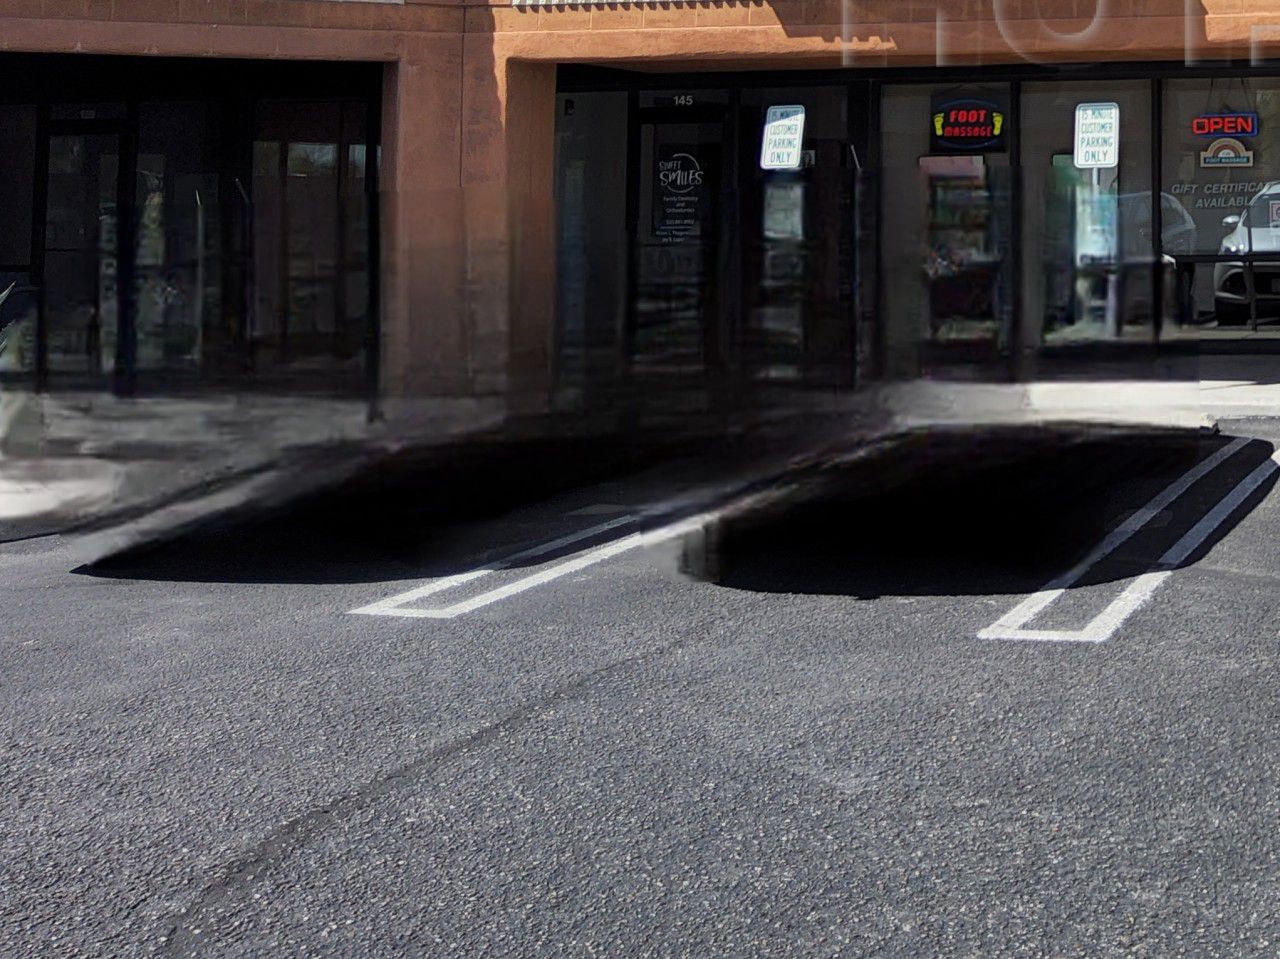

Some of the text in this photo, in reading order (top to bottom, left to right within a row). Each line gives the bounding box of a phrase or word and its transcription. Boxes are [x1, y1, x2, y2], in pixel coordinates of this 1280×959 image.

[673, 95, 693, 106] 145
[950, 110, 987, 123] FOOT
[943, 125, 992, 137] MASSAGE
[1192, 116, 1253, 135] OPEN
[768, 138, 797, 149] PARKING
[1081, 137, 1113, 147] PARKING
[770, 151, 792, 163] ONLY
[1084, 151, 1108, 162] ONLY
[659, 170, 704, 186] SMILES
[1171, 184, 1199, 194] GIFT
